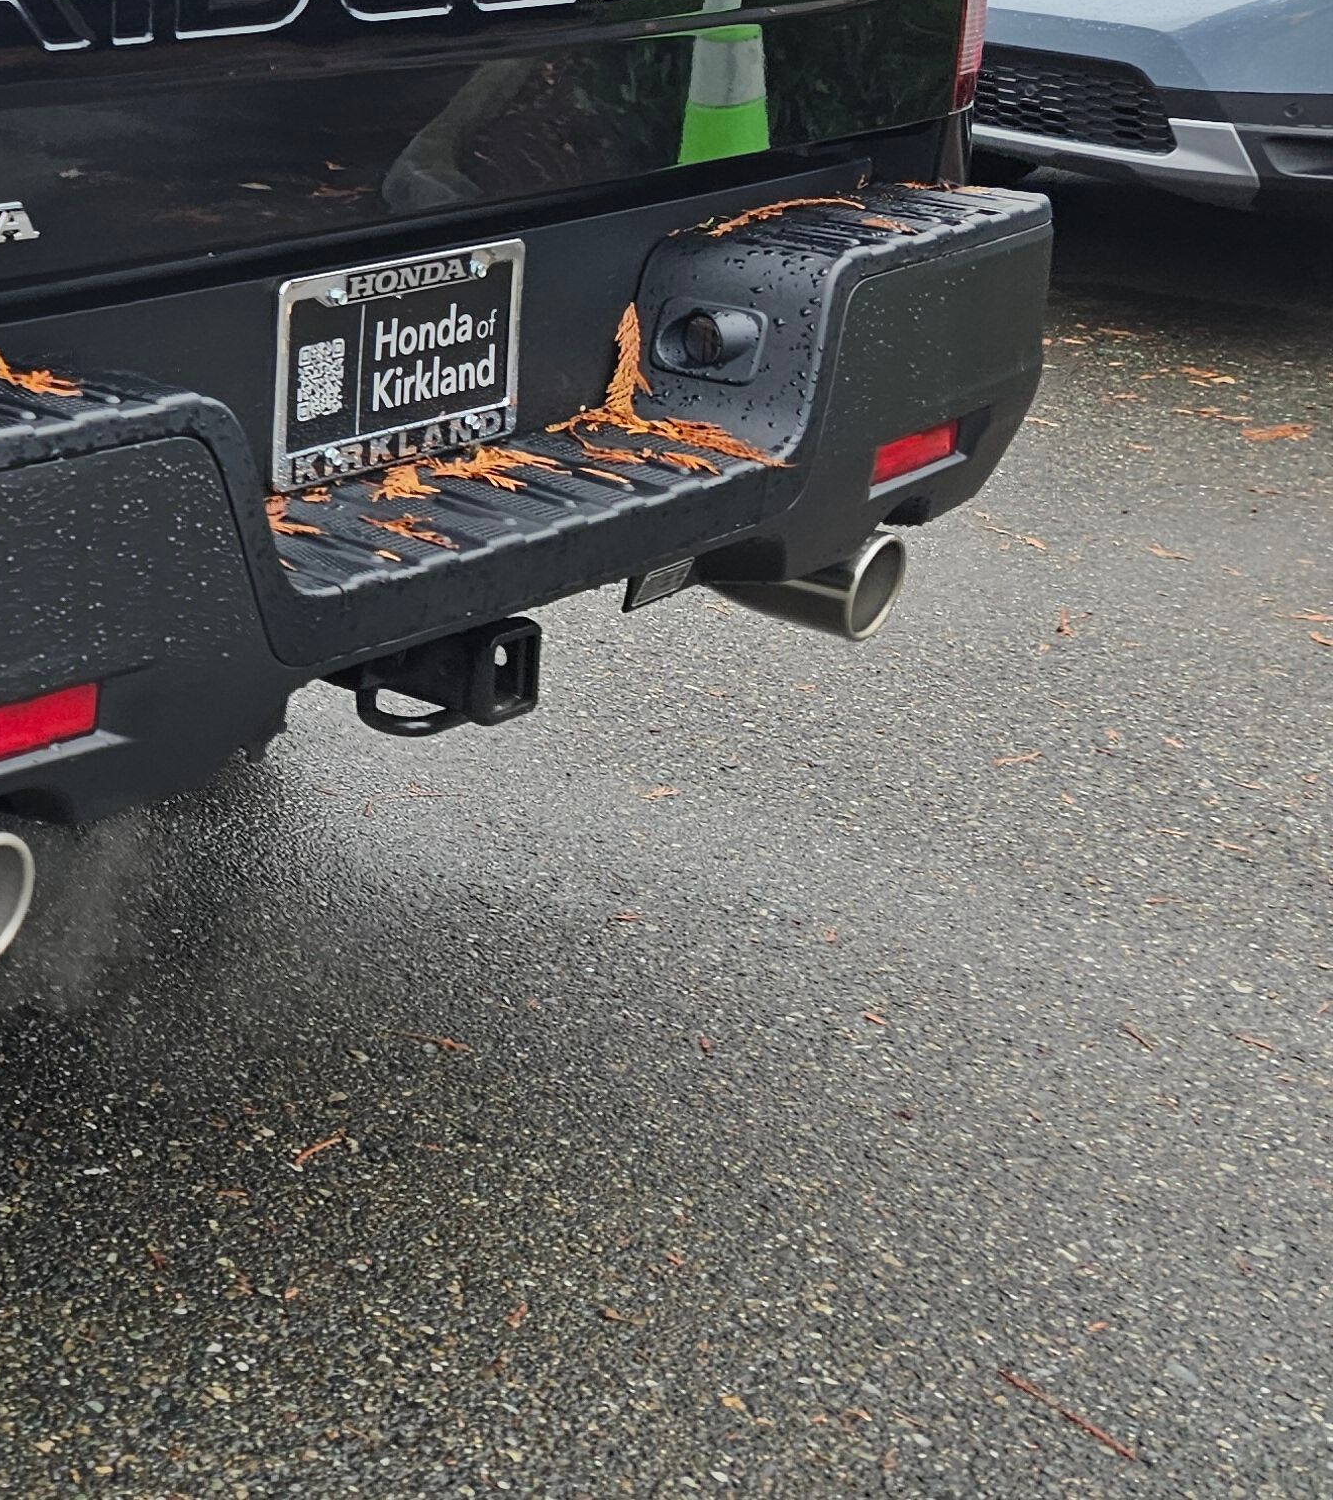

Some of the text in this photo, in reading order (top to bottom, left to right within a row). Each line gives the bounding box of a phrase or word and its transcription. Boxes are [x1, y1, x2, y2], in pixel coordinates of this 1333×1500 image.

[348, 259, 467, 299] HONDA
[374, 302, 498, 362] Honda of
[372, 343, 496, 412] Kirkland
